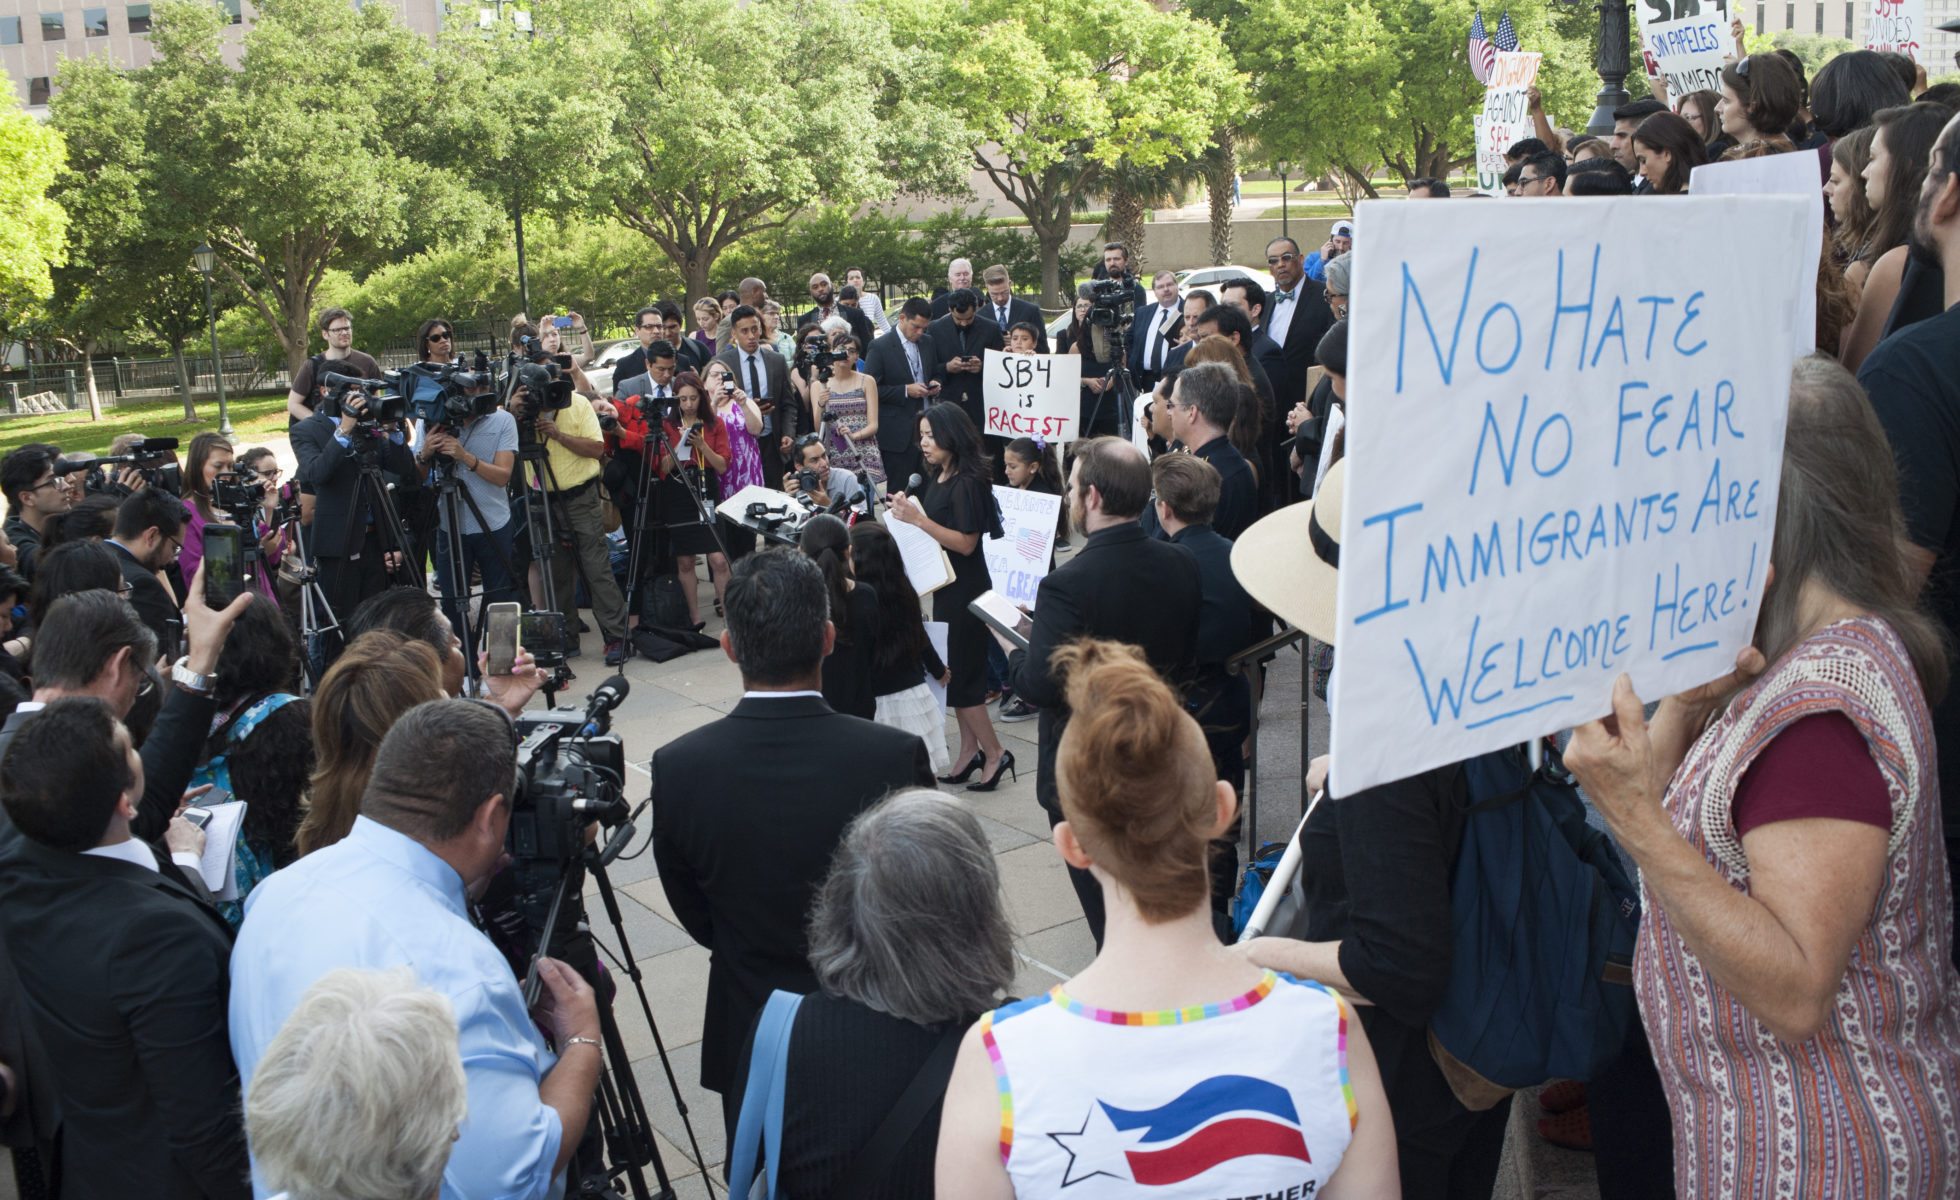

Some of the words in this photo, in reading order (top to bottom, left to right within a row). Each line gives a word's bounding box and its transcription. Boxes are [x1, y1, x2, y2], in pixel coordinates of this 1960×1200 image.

[1651, 34, 1670, 58] SIN
[1667, 24, 1719, 56] PAPELES
[1869, 16, 1912, 43] DIVIDES
[1664, 72, 1684, 97] SIN
[1486, 89, 1528, 124] AGAINST
[1490, 125, 1511, 153] SB4
[1396, 245, 1522, 394] NO
[1545, 243, 1708, 372] HATE
[998, 356, 1051, 389] SB4
[1018, 393, 1034, 408] is
[988, 407, 1070, 437] RACIST
[1469, 394, 1573, 496] NO
[1614, 380, 1744, 468] FEAR
[1354, 492, 1680, 625] IMMIGRANTS
[1692, 458, 1760, 534] ARE
[1006, 570, 1042, 601] GREA
[1404, 614, 1631, 726] WELCOME
[1649, 542, 1757, 651] HERE!
